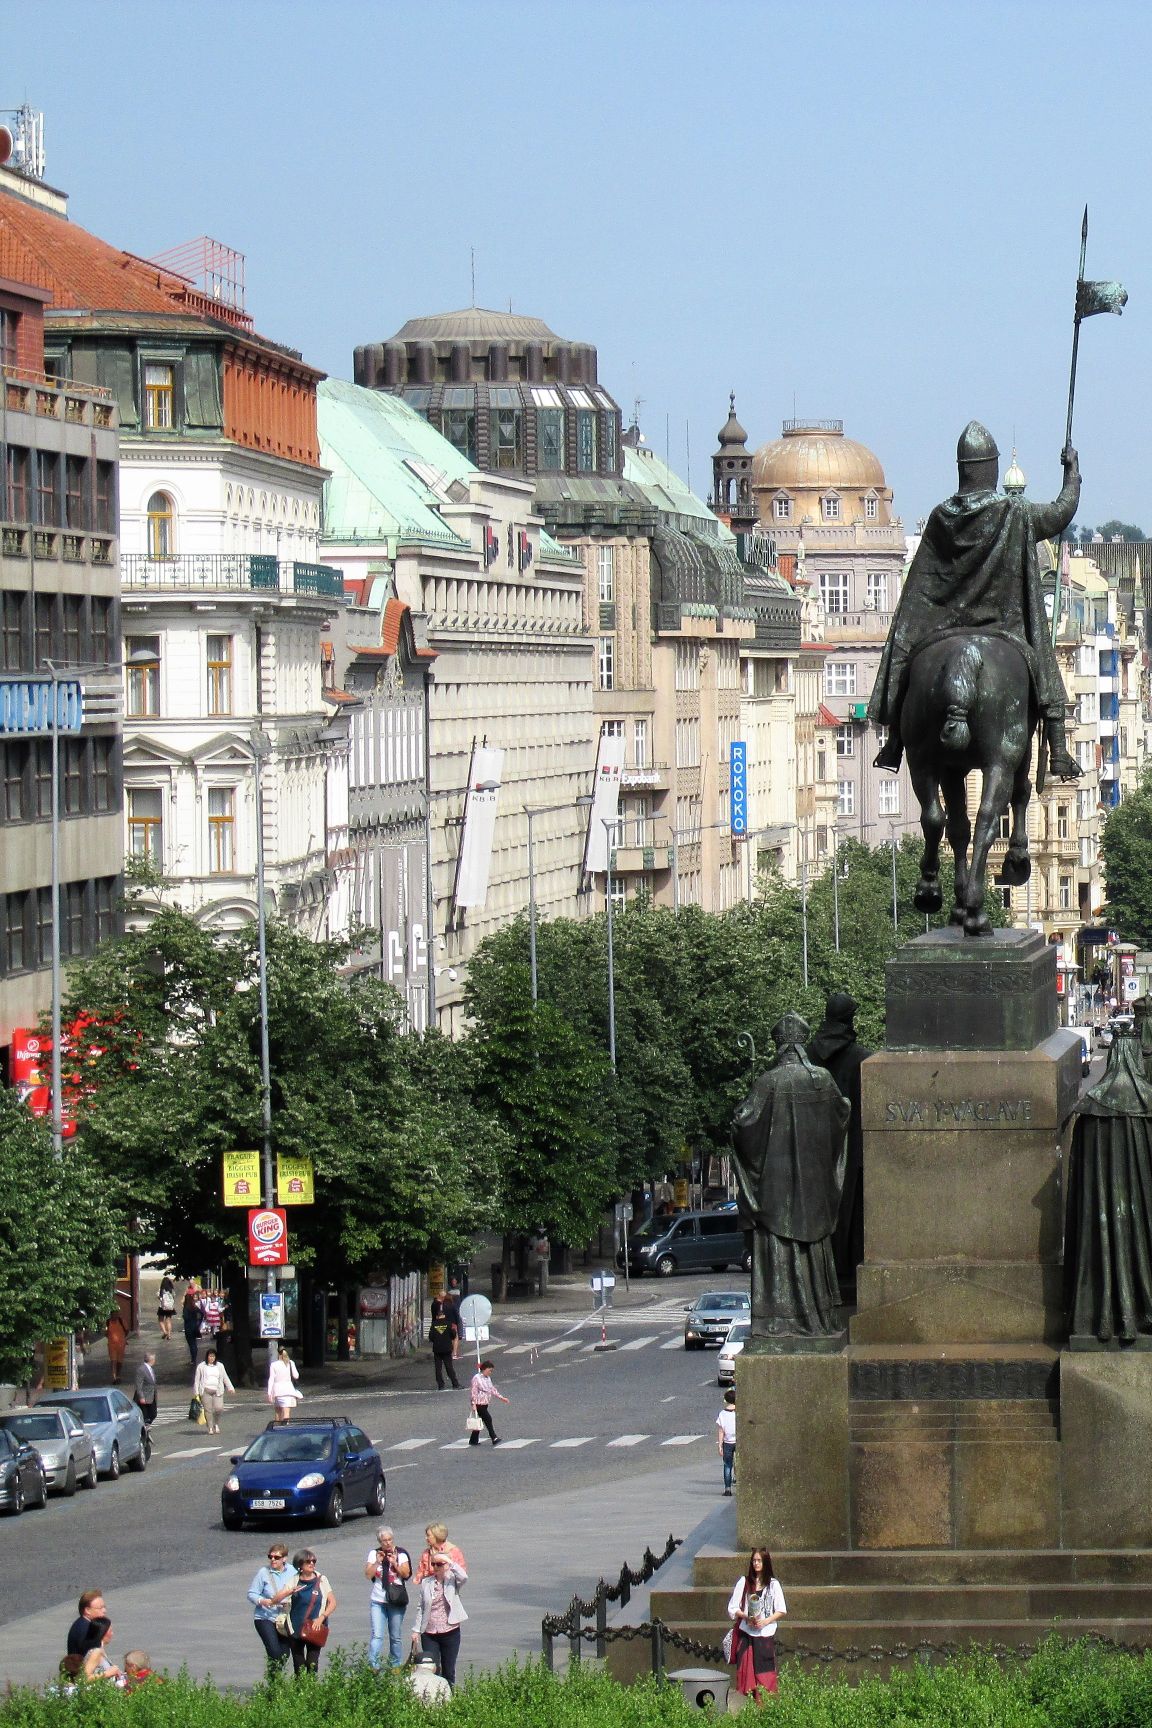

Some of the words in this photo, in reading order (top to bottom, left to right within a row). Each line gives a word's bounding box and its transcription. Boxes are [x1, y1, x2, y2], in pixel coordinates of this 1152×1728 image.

[733, 747, 743, 829] ROKOKO
[256, 1218, 278, 1229] BURGER
[257, 1224, 280, 1236] KING
